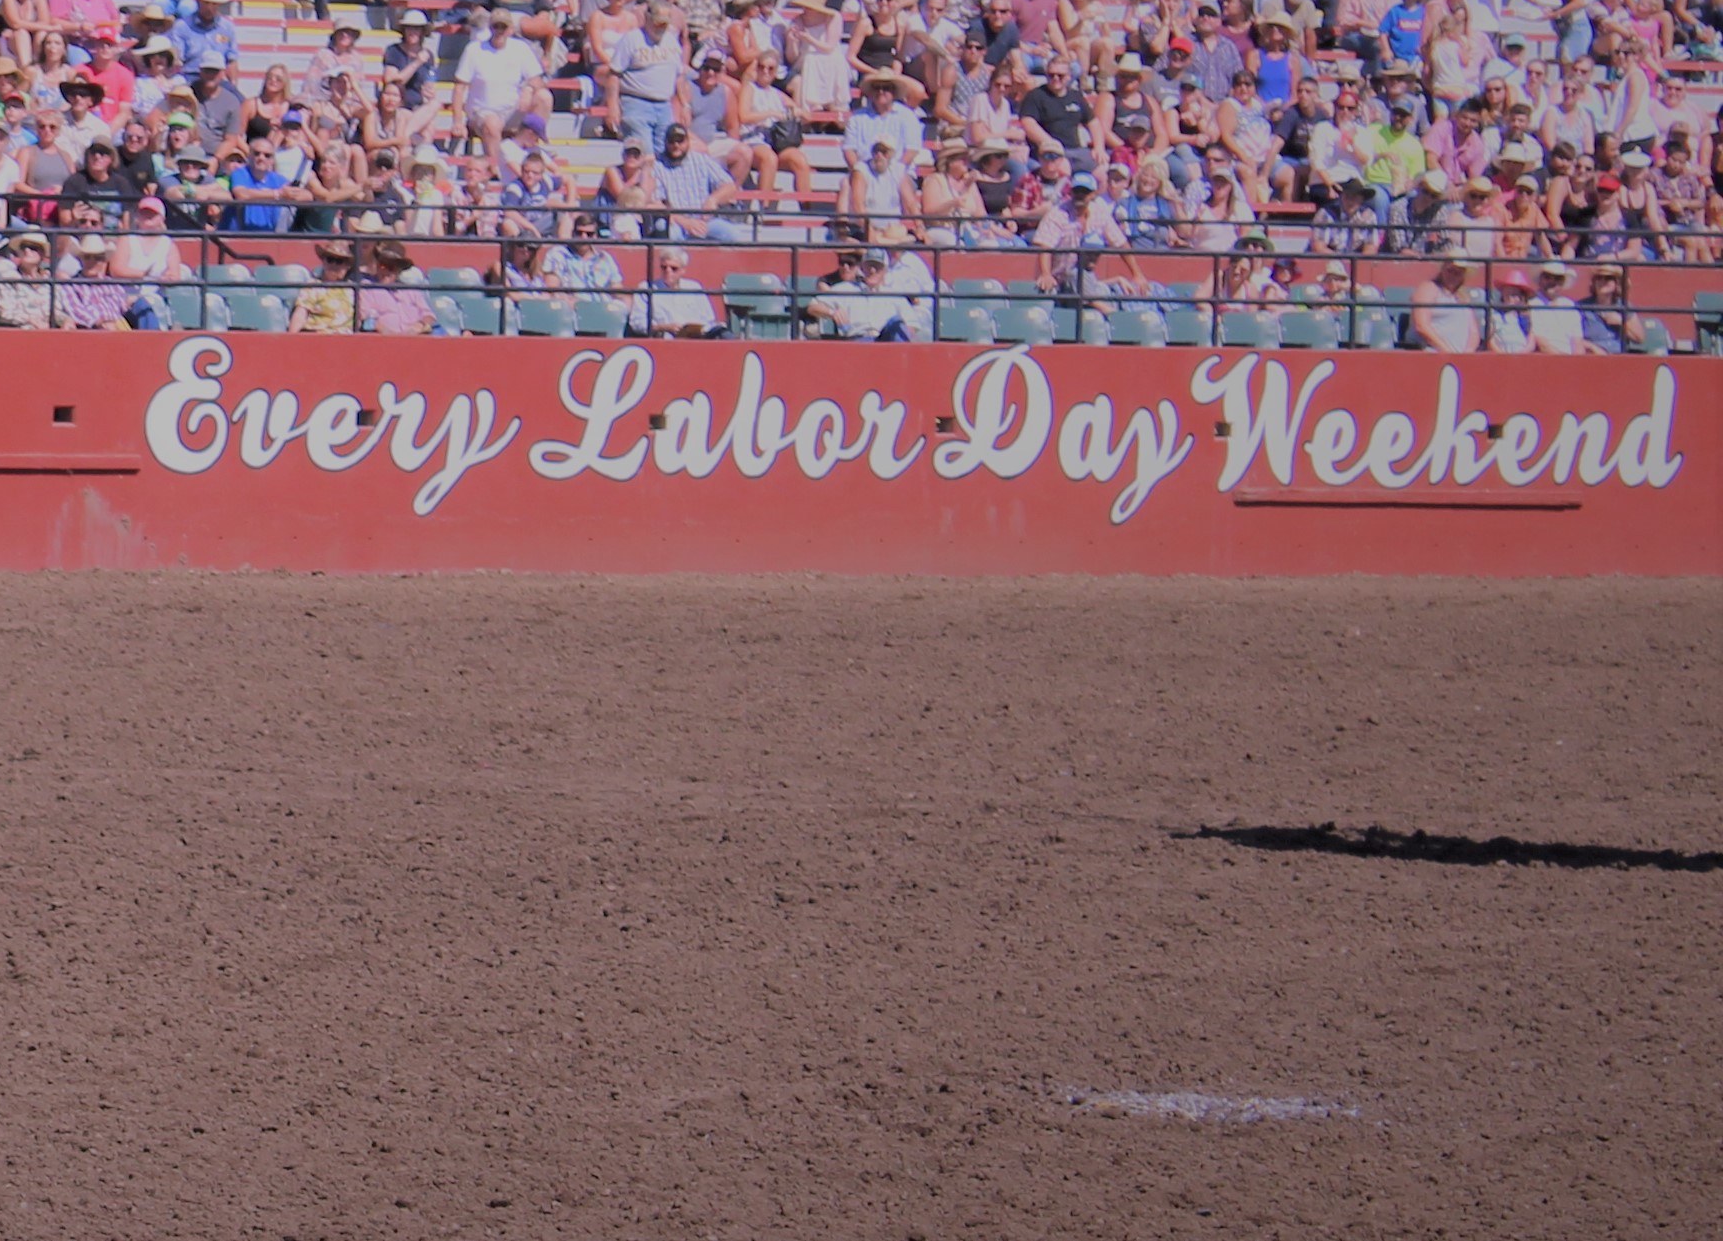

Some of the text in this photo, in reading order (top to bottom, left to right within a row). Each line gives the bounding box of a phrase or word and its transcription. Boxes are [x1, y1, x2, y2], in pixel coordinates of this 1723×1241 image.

[145, 336, 1684, 525] Every Labor Day Weekend
